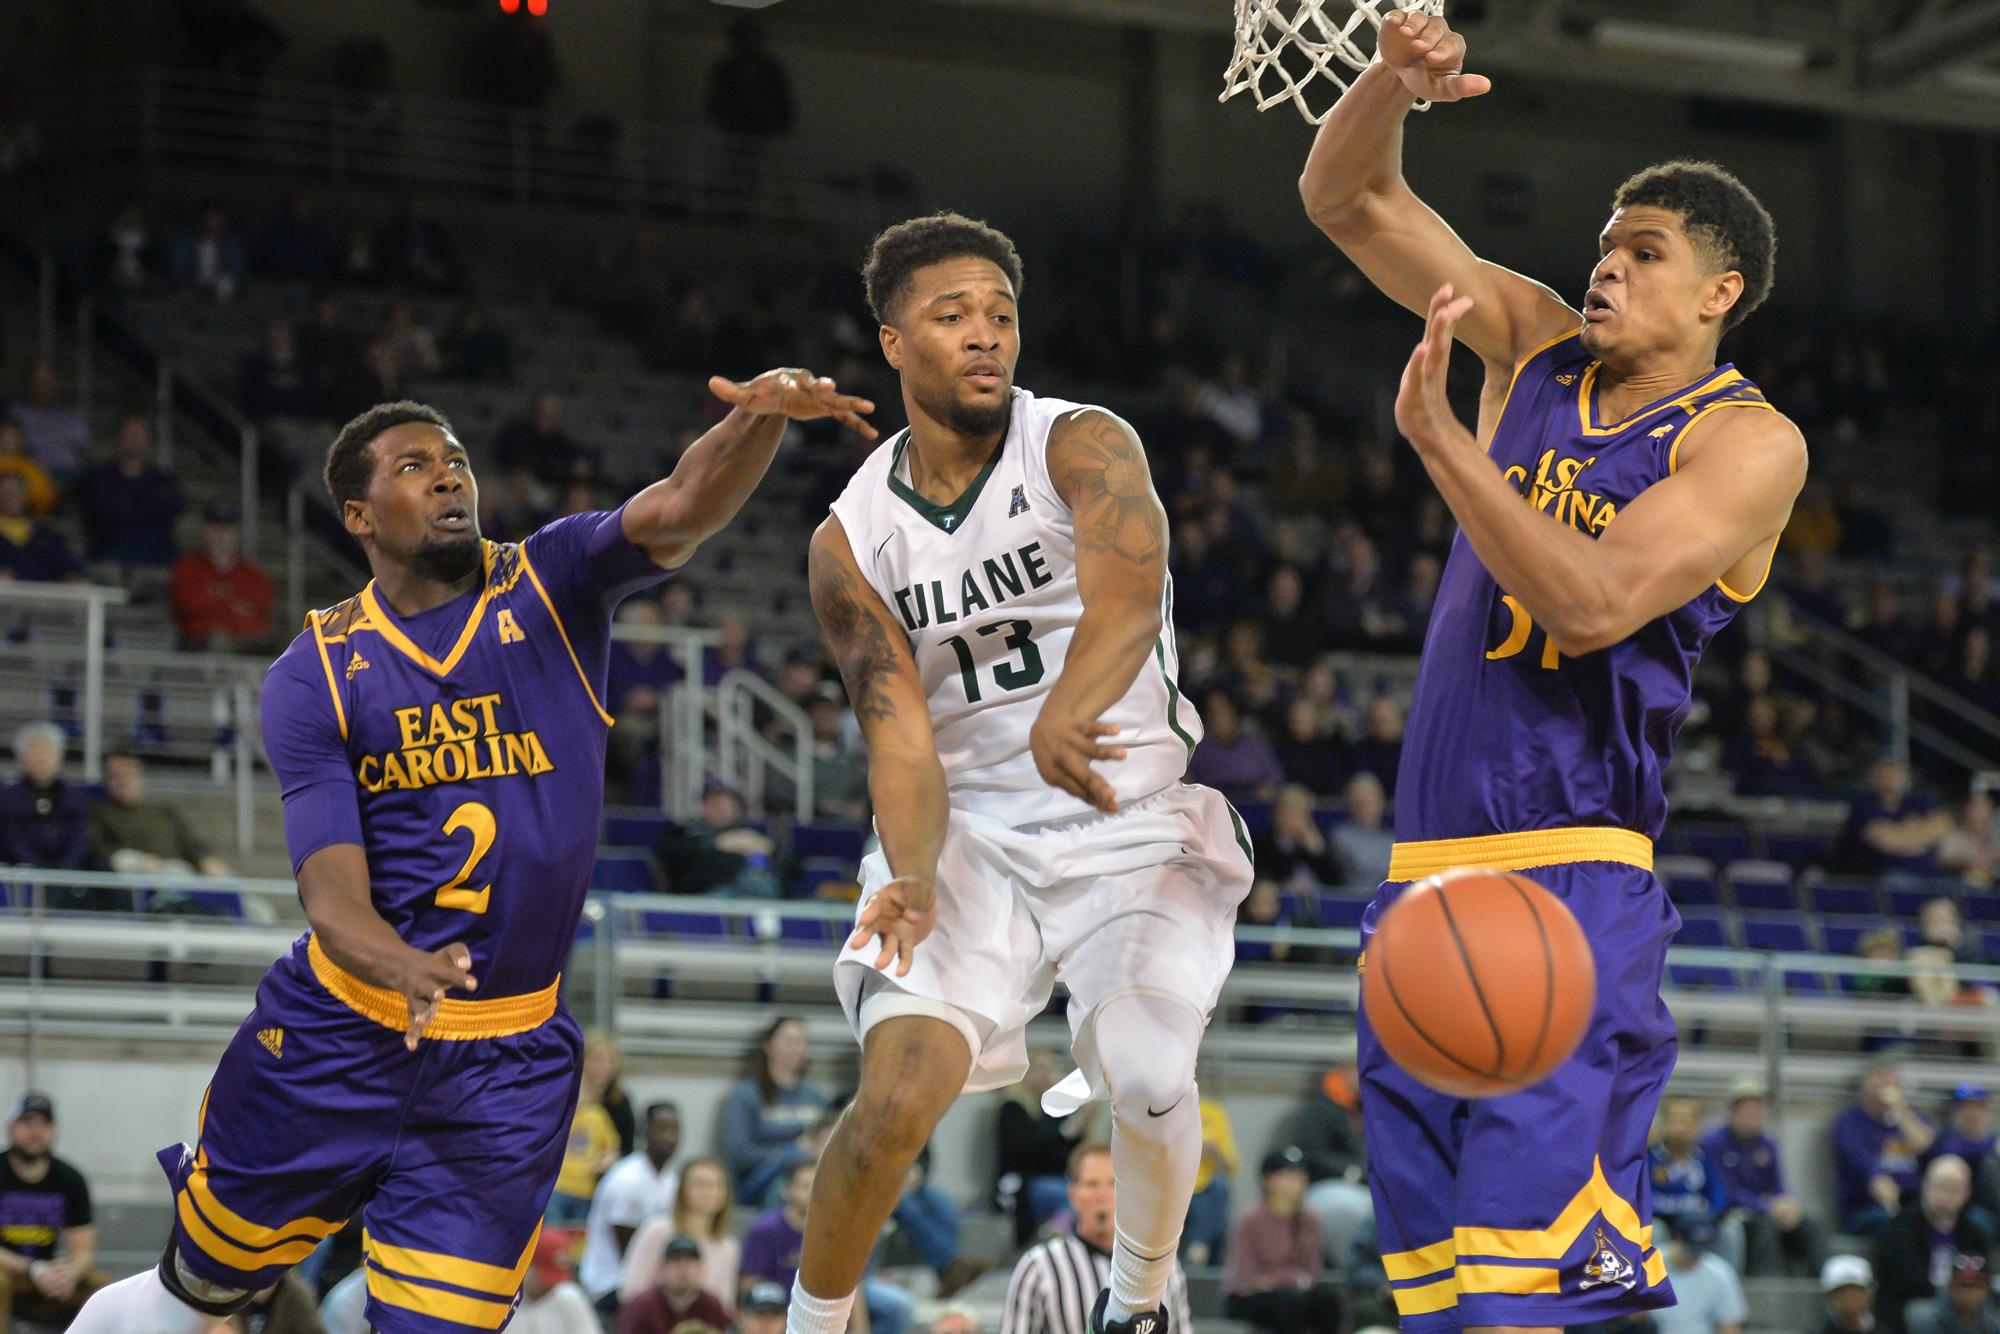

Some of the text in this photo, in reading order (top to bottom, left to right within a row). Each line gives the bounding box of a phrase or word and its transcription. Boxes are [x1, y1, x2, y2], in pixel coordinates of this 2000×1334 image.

[944, 516, 954, 529] T
[1008, 483, 1031, 518] A
[895, 541, 1053, 631] TULANE
[497, 608, 525, 645] A
[938, 619, 1045, 703] 13
[394, 693, 501, 750] EAST
[358, 731, 555, 793] CAROLINA
[435, 802, 497, 914] 2
[256, 1030, 283, 1059] adidas
